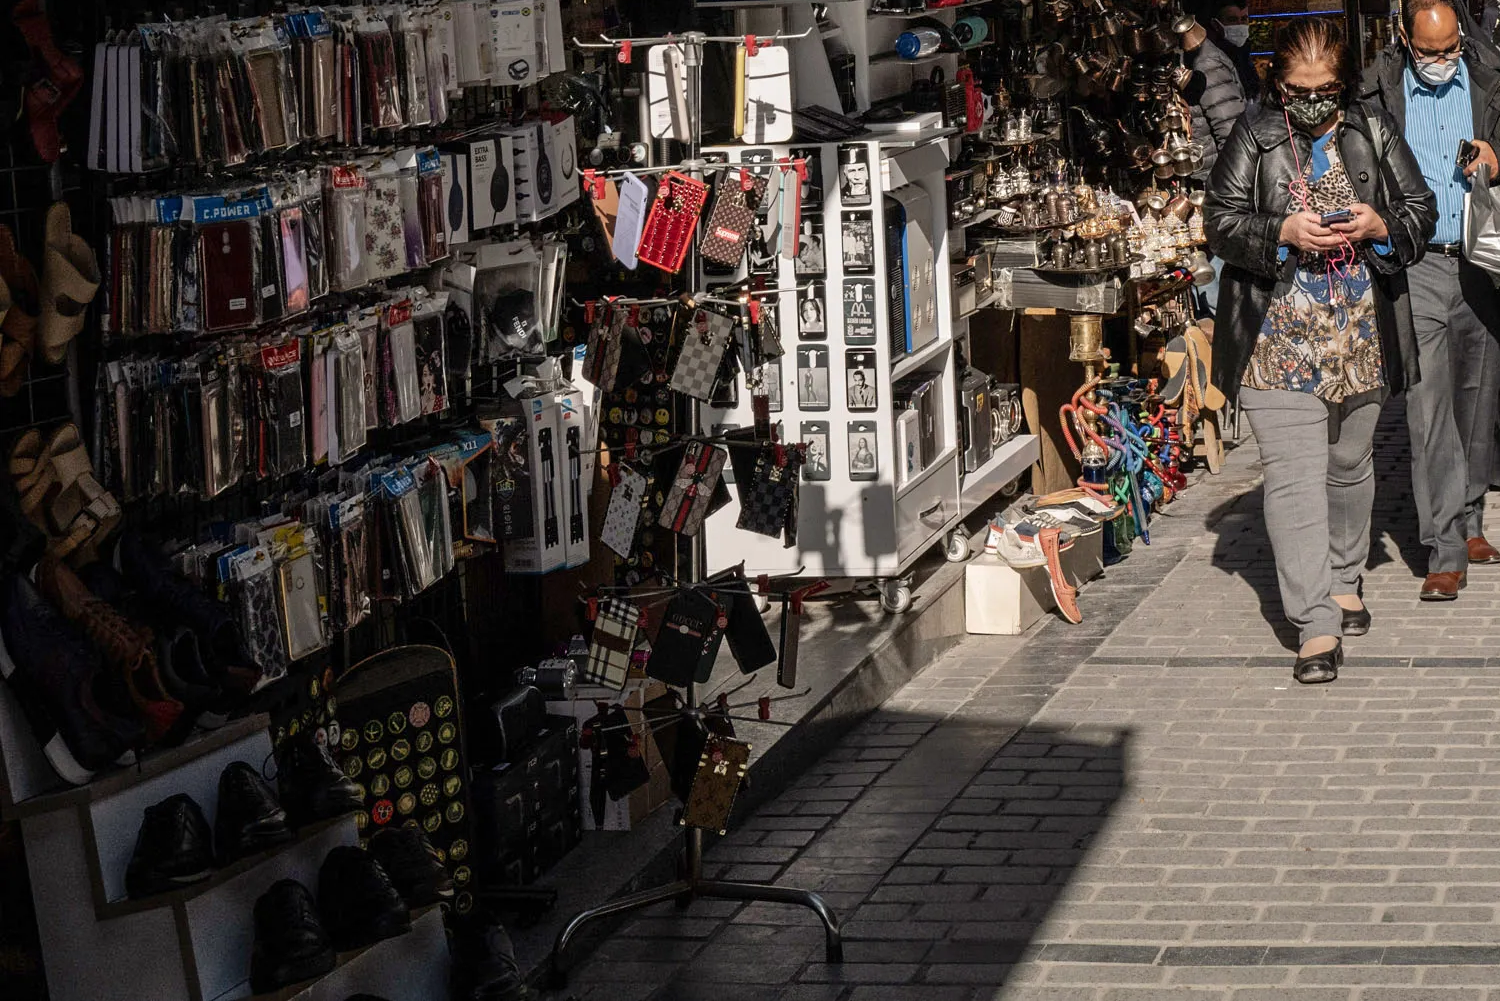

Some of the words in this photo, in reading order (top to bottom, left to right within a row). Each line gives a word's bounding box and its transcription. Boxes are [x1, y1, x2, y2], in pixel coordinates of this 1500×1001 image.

[474, 146, 490, 155] EXTRA
[474, 154, 488, 164] BASS
[203, 204, 251, 220] C.POWER
[511, 315, 528, 339] FENDI
[462, 440, 479, 452] X11
